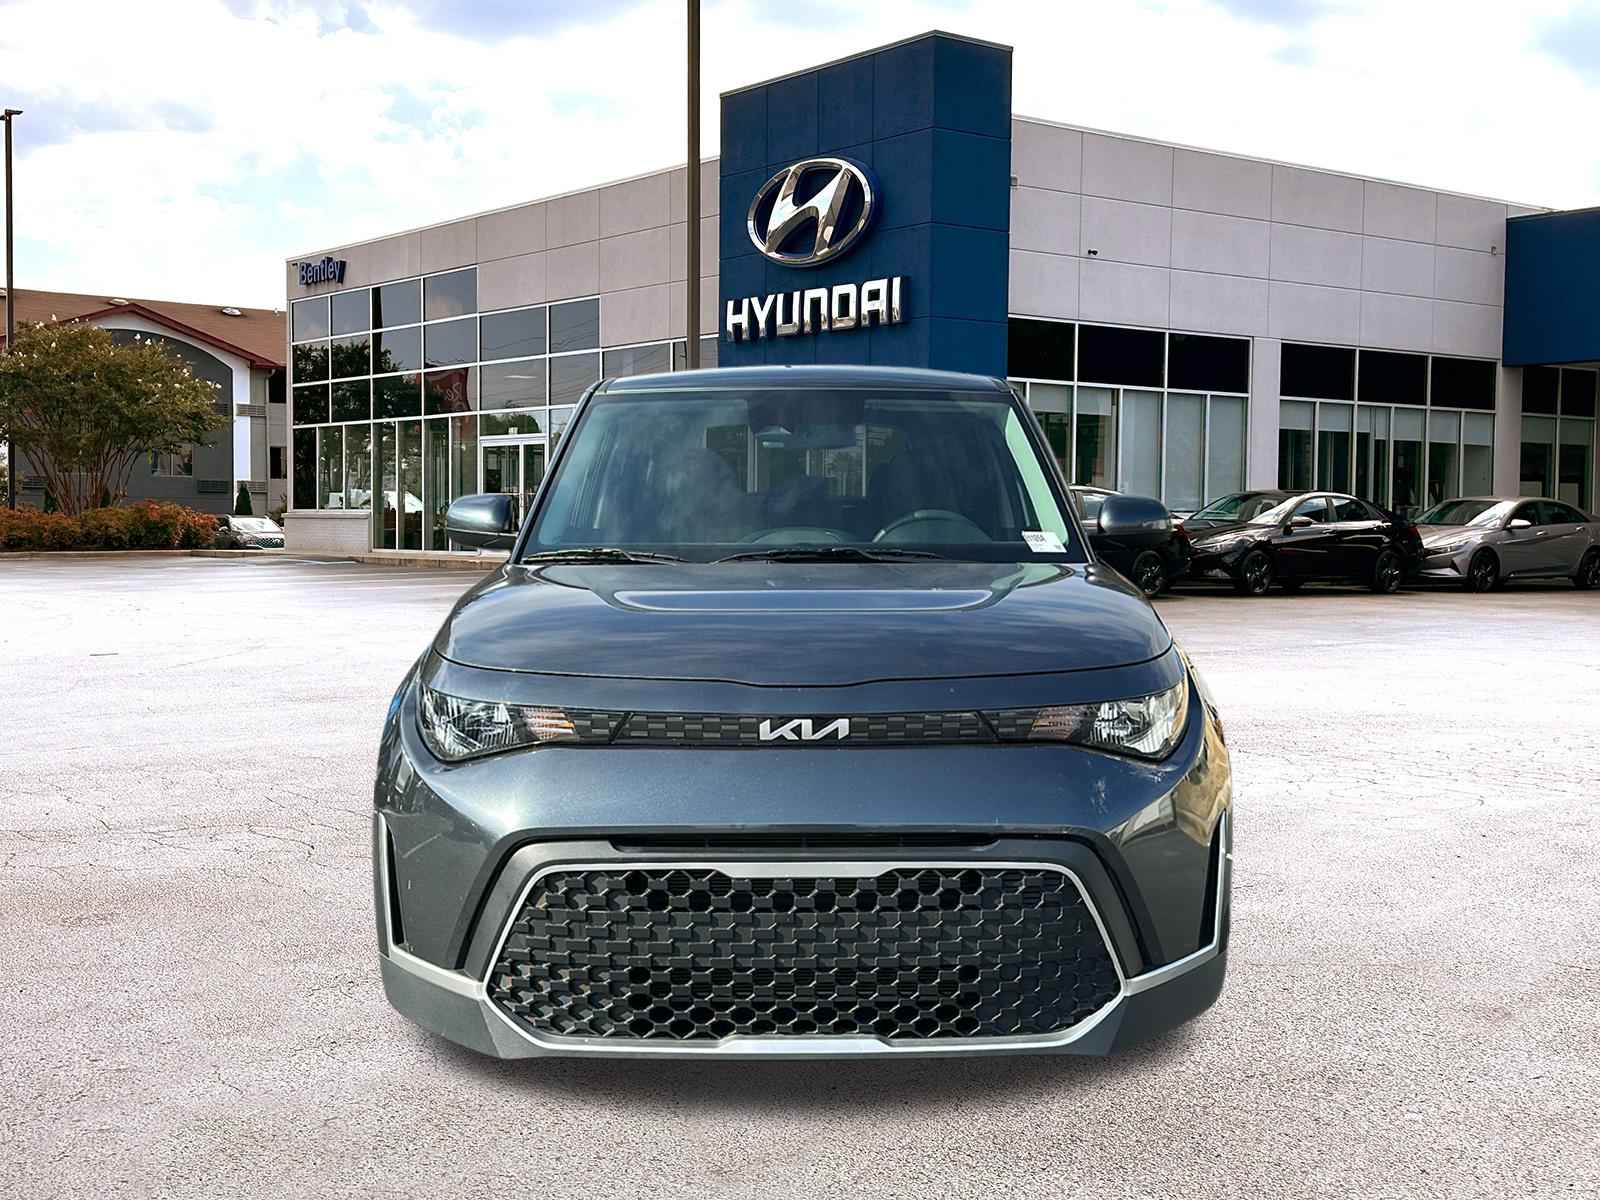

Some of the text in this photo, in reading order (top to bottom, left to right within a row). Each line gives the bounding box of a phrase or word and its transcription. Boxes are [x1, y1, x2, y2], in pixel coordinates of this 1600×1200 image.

[299, 256, 346, 285] Bentley
[726, 276, 906, 342] HYUNDAI
[760, 719, 850, 740] KIA
